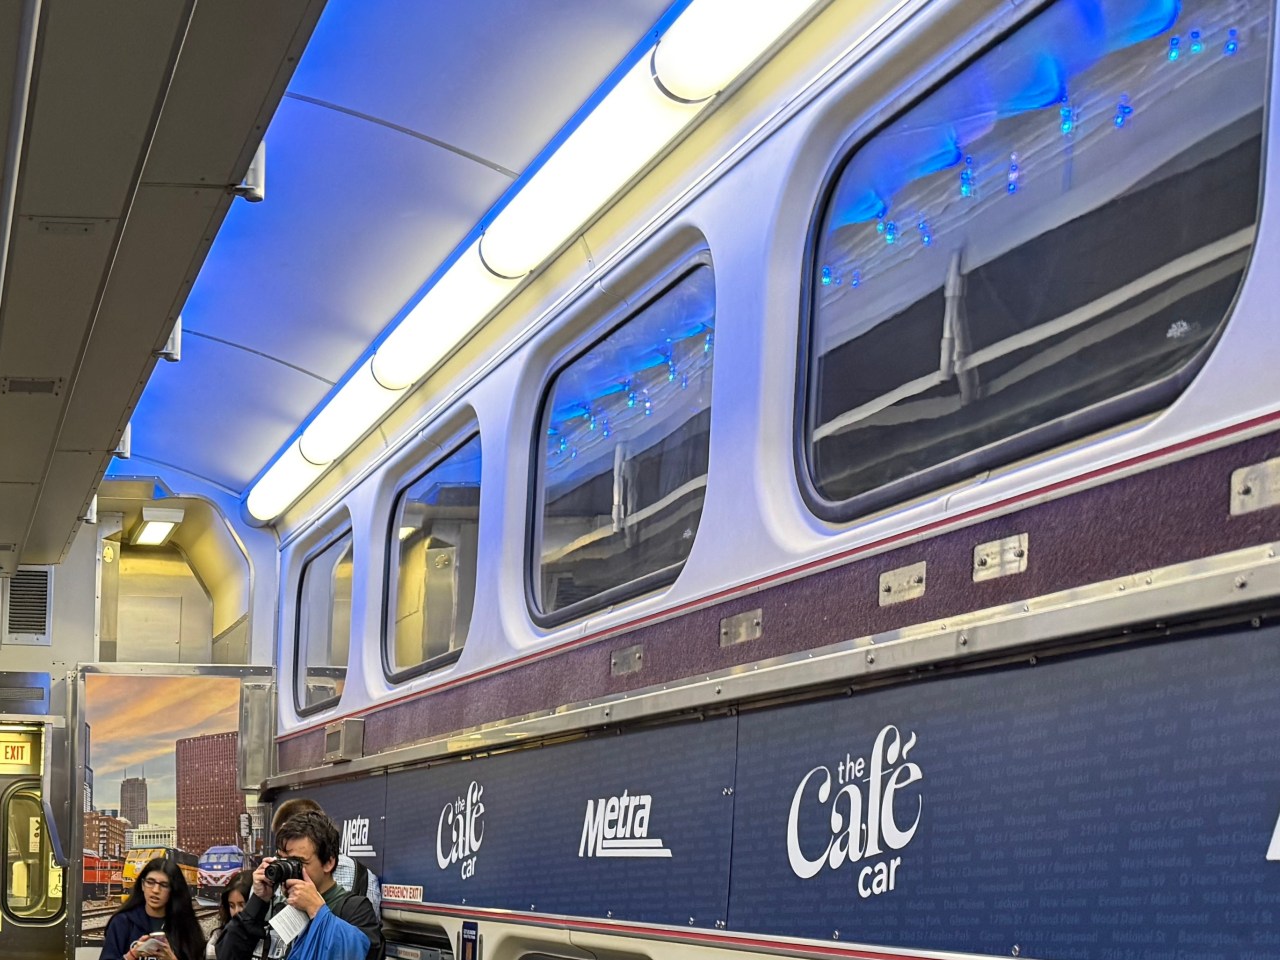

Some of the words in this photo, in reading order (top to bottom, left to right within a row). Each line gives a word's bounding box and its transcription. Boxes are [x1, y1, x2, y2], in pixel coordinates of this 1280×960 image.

[4, 745, 25, 760] EXIT
[838, 753, 866, 781] the
[455, 796, 466, 813] the
[787, 724, 923, 879] Café
[341, 815, 369, 856] Metra
[436, 780, 485, 870] Café
[579, 789, 652, 858] Metra
[461, 856, 476, 881] car
[857, 855, 902, 898] car
[384, 886, 408, 898] EMERGENCY
[409, 886, 419, 899] EXIT
